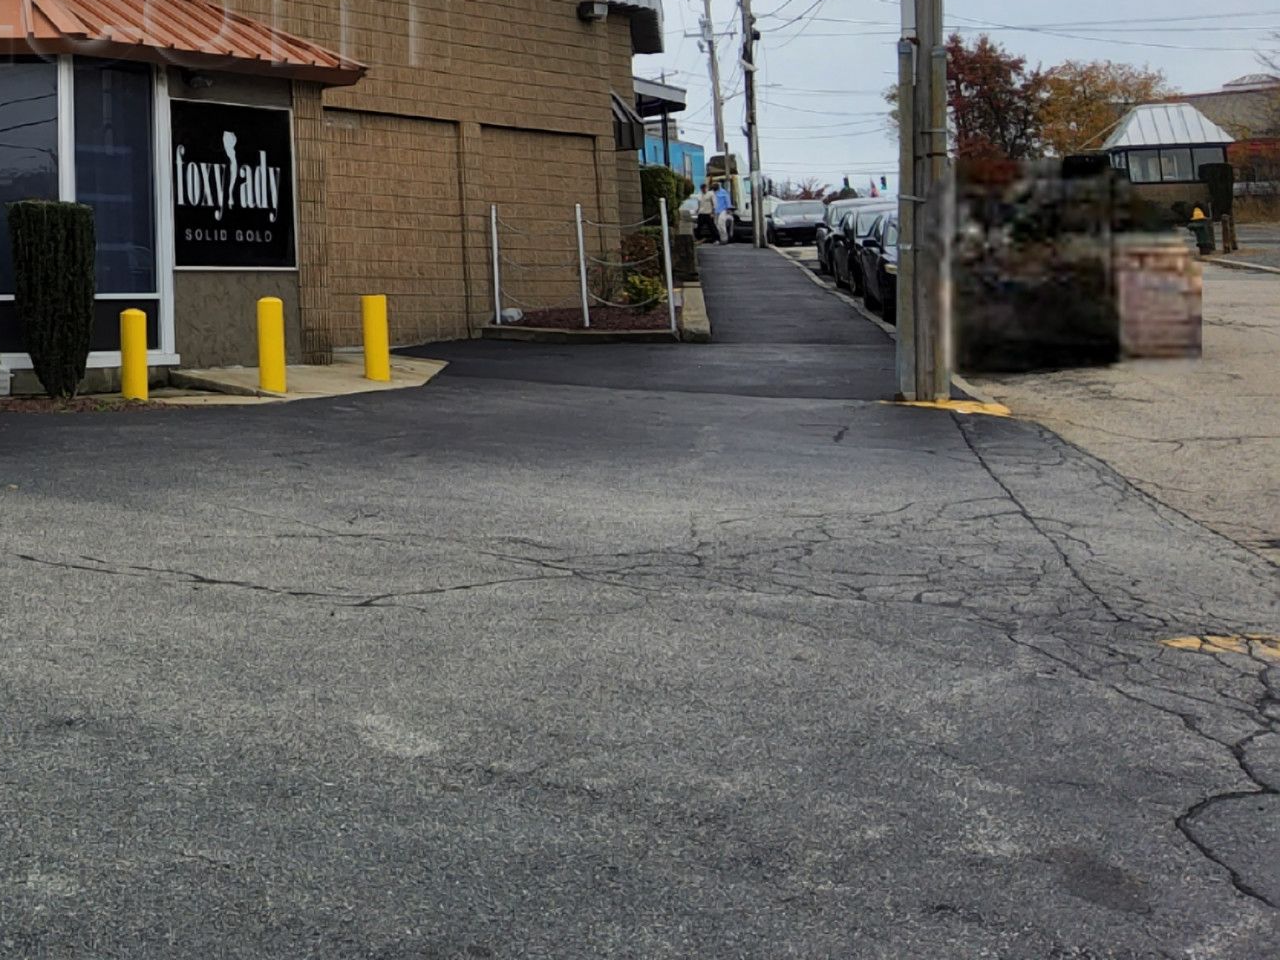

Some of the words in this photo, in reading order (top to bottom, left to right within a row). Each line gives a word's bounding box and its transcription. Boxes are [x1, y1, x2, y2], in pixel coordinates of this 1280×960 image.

[176, 144, 226, 221] foxy
[185, 228, 228, 241] SOLID
[235, 229, 273, 242] GOLD
